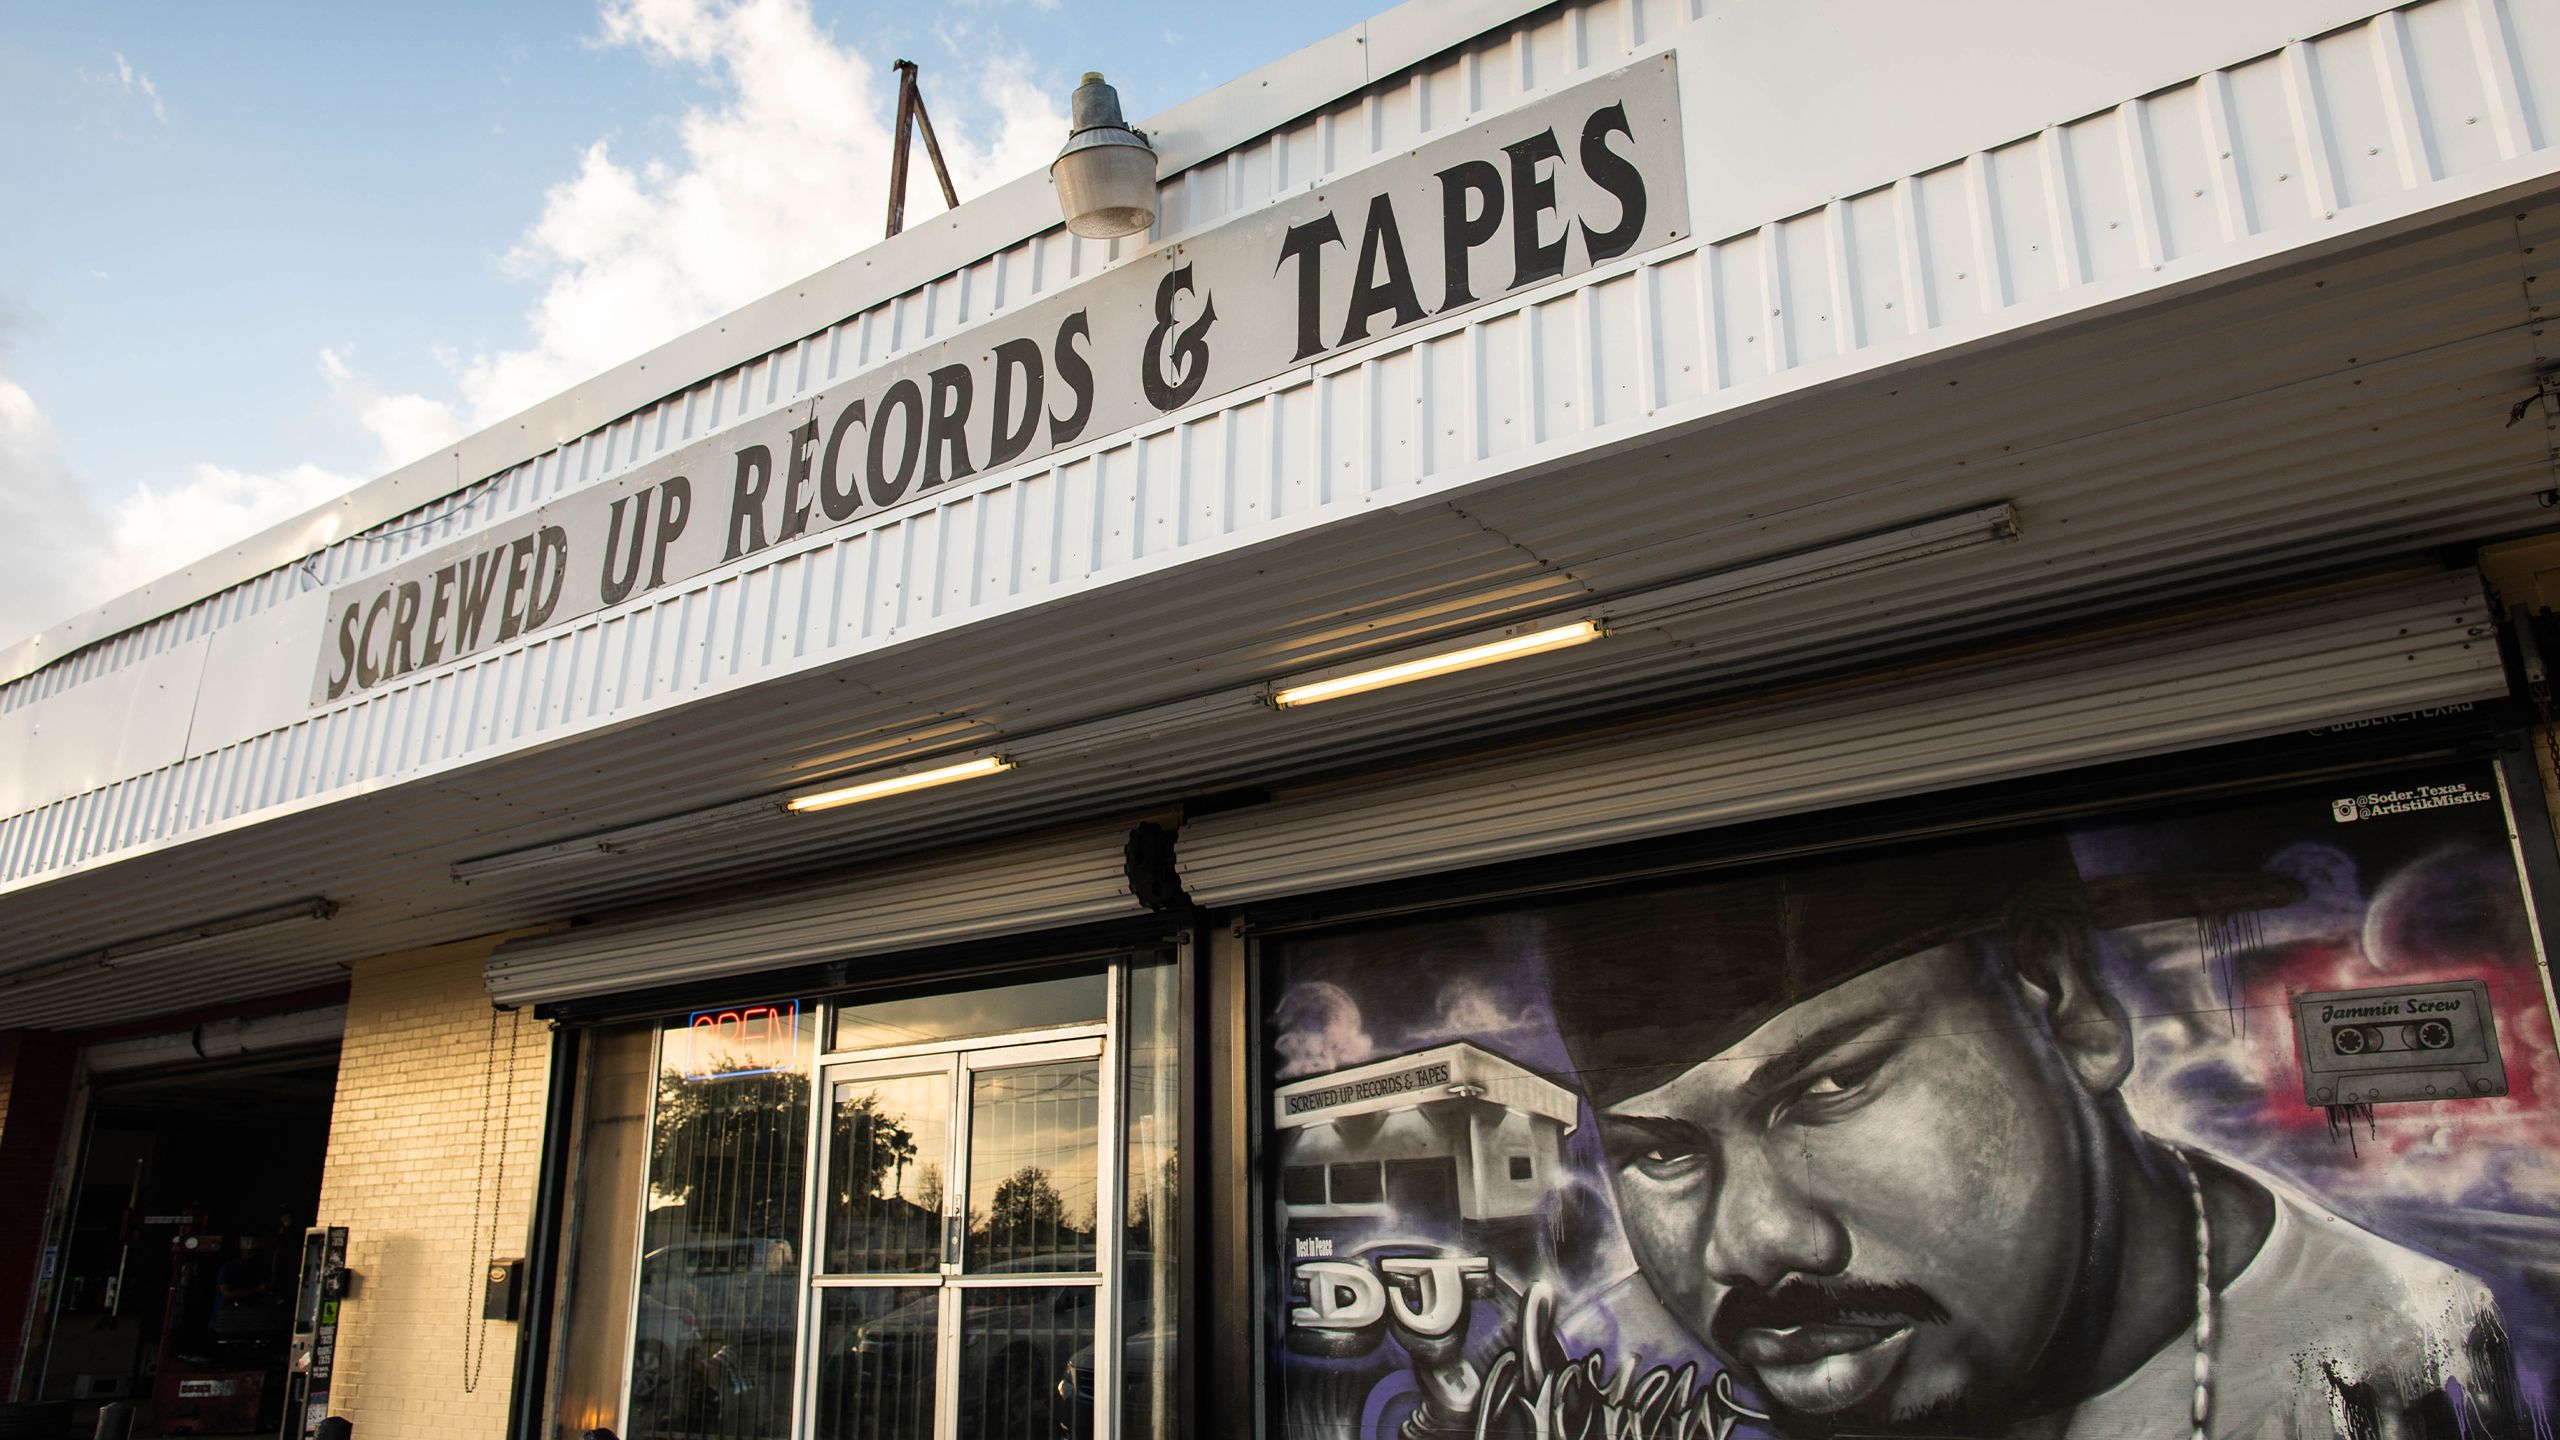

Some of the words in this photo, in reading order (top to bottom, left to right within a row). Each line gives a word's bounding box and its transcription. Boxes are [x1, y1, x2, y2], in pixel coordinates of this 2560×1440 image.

[328, 525, 568, 700] SCREWED
[600, 476, 692, 605] UP
[721, 306, 1095, 563] RECORDS
[1142, 261, 1218, 411] &
[1274, 98, 1647, 363] TAPES
[2356, 783, 2467, 808] @Soder_Texas
[2359, 790, 2492, 820] @ArtistikMisfits
[2322, 1001, 2400, 1023] Jammin
[2405, 998, 2461, 1014] Screw
[692, 1004, 796, 1066] OPEN
[1290, 1090, 1338, 1114] SCREWED
[1340, 1087, 1354, 1104] UP
[1356, 1074, 1403, 1098] RECORDS
[1404, 1074, 1413, 1090] &
[1417, 1064, 1449, 1087] TAPES
[1315, 1236, 1333, 1257] Peace
[1291, 1256, 1489, 1336] DJ
